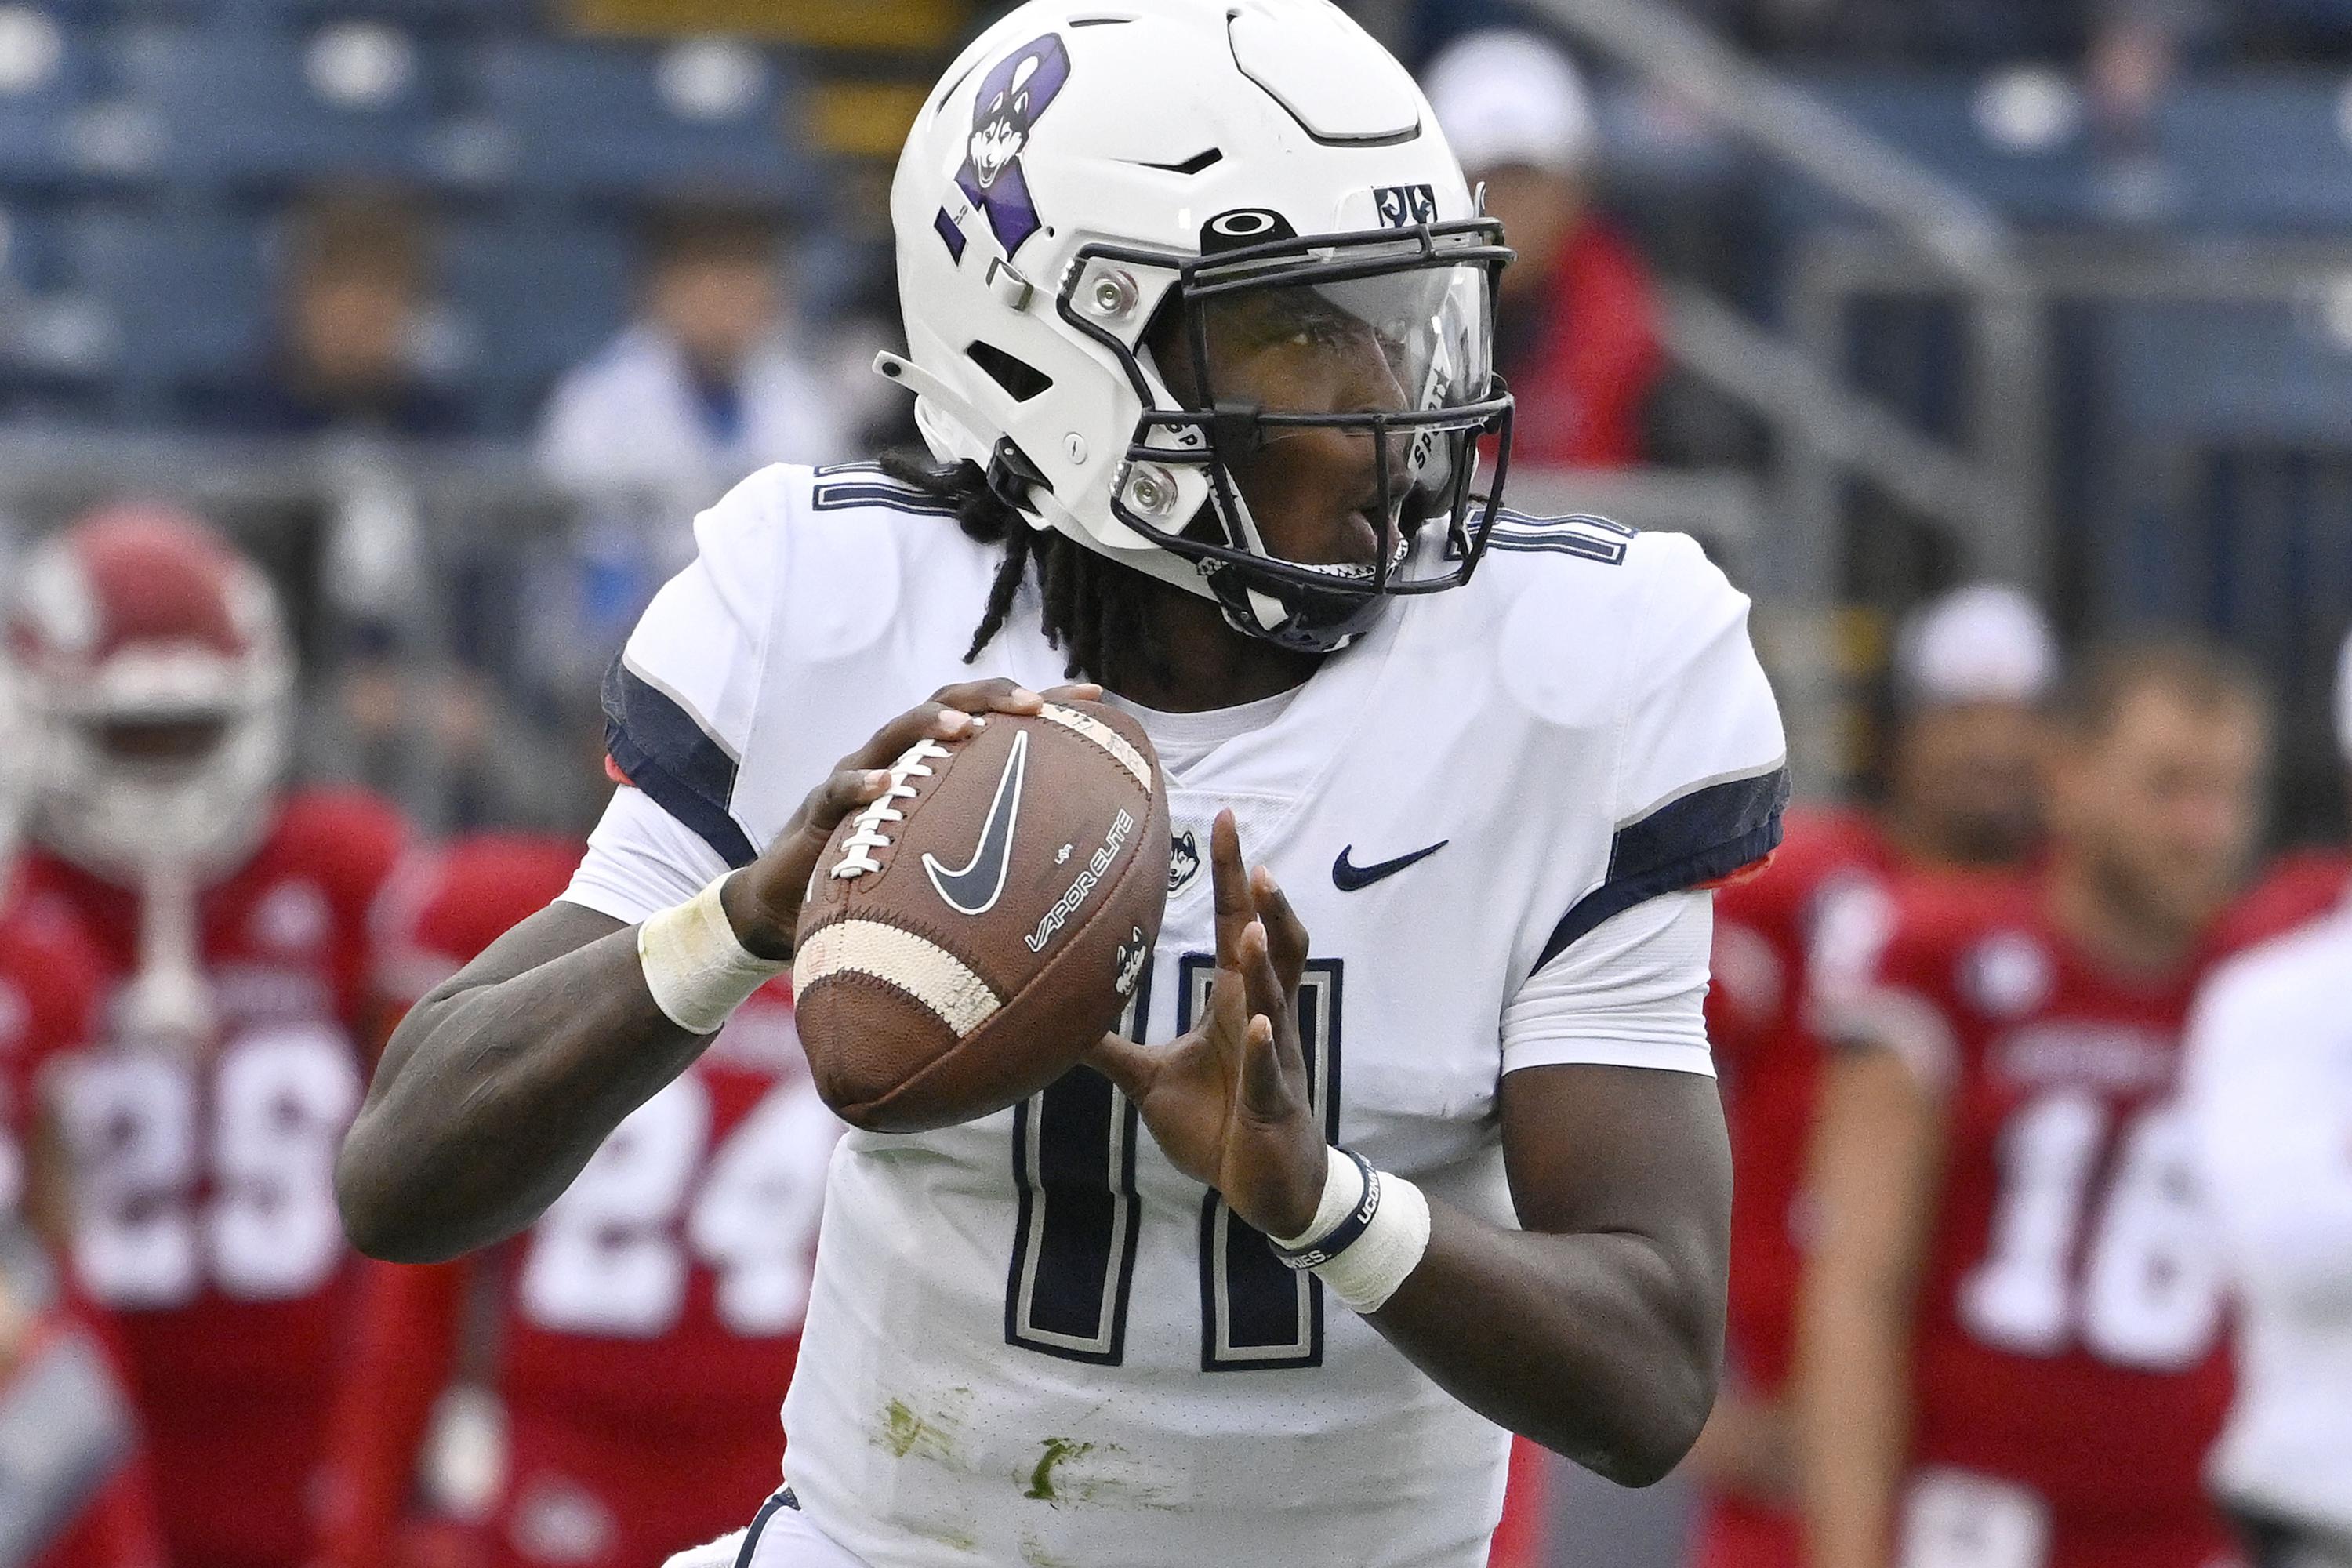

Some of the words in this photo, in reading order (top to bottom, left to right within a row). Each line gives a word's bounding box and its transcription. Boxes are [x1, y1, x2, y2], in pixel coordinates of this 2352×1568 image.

[1024, 871, 1098, 953] VAPOR
[1089, 808, 1134, 877] ELITE
[1004, 951, 1345, 1372] 11
